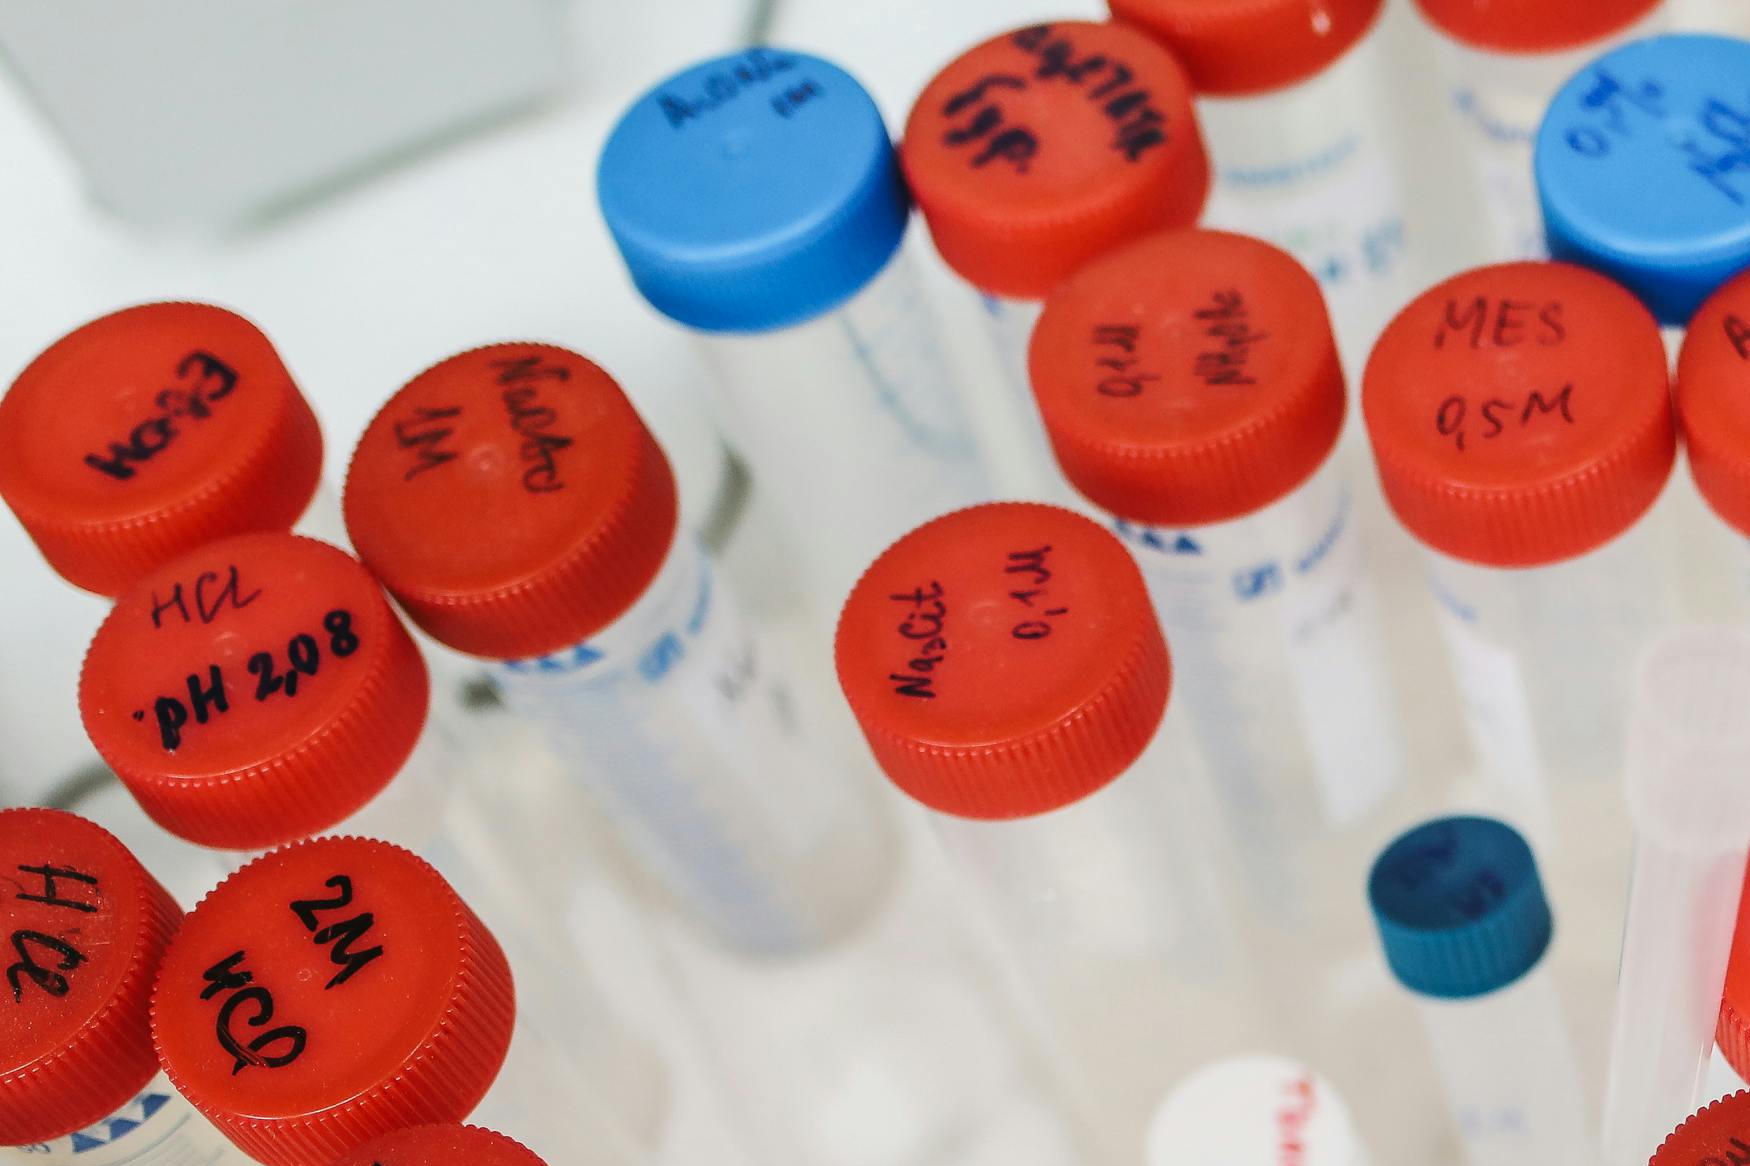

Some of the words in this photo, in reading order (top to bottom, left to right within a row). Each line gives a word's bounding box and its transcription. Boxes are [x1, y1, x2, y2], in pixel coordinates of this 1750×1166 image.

[1432, 296, 1568, 350] MES
[1436, 384, 1575, 451] 0,5M
[247, 608, 360, 700] 2,08
